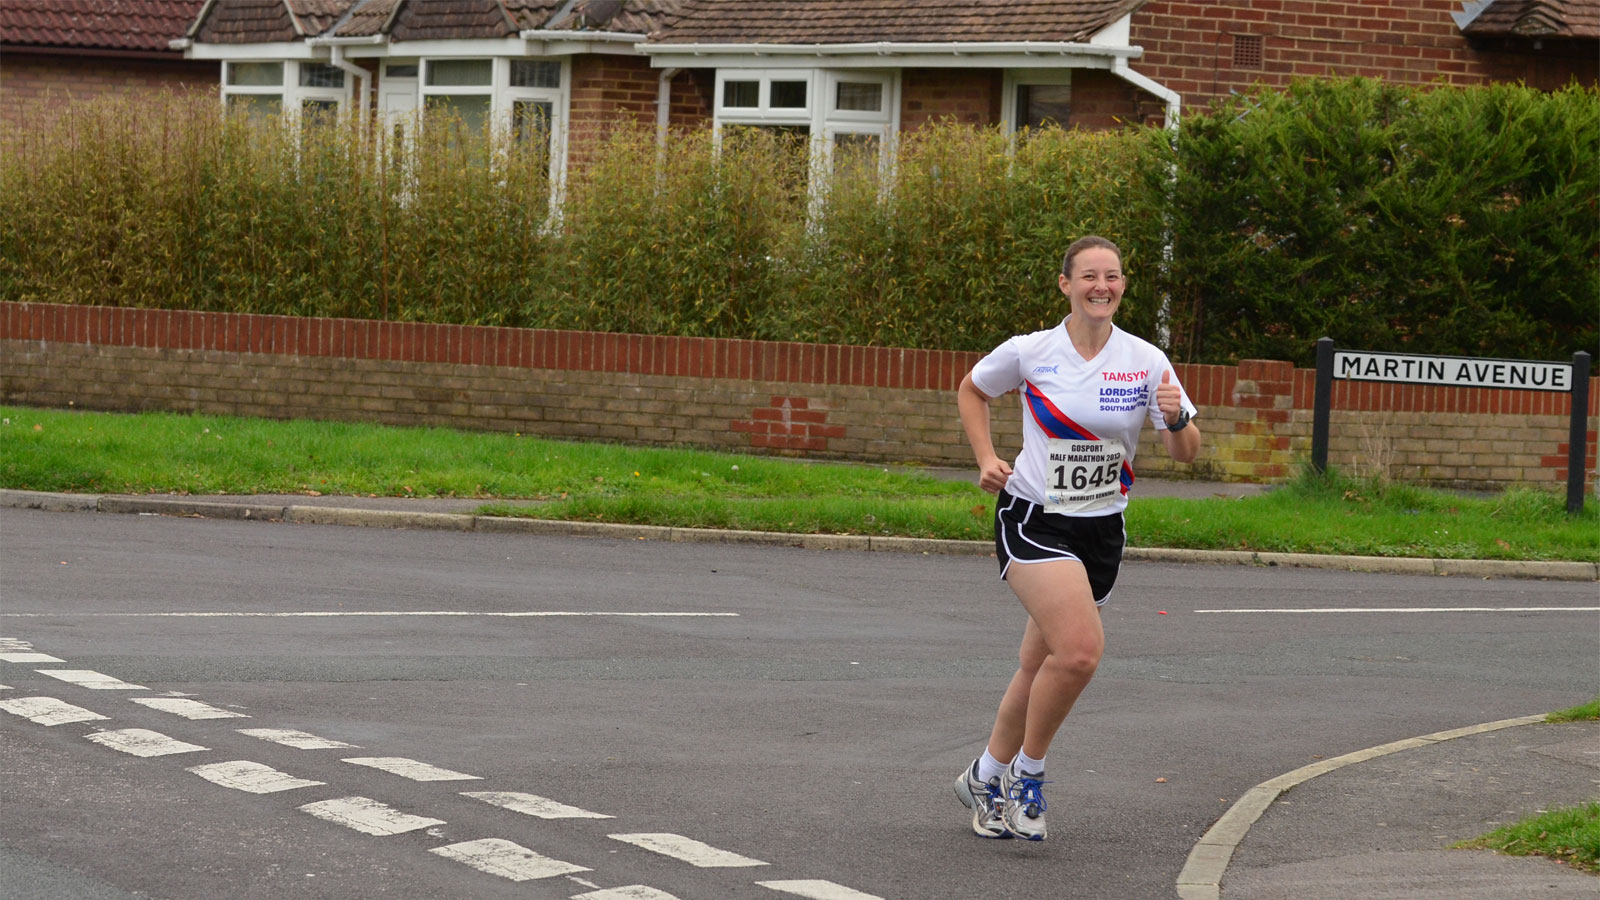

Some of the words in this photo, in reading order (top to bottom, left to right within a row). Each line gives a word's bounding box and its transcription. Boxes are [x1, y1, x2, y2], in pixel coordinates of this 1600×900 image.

[1102, 369, 1149, 382] TAMSYN
[1341, 356, 1445, 380] MARTIN
[1455, 363, 1565, 387] AVENUE
[1099, 385, 1149, 396] LORDSHL
[1071, 444, 1104, 453] GOSPORT
[1050, 453, 1066, 461] HALF
[1068, 454, 1105, 462] MARATHON
[1053, 462, 1118, 490] 1645
